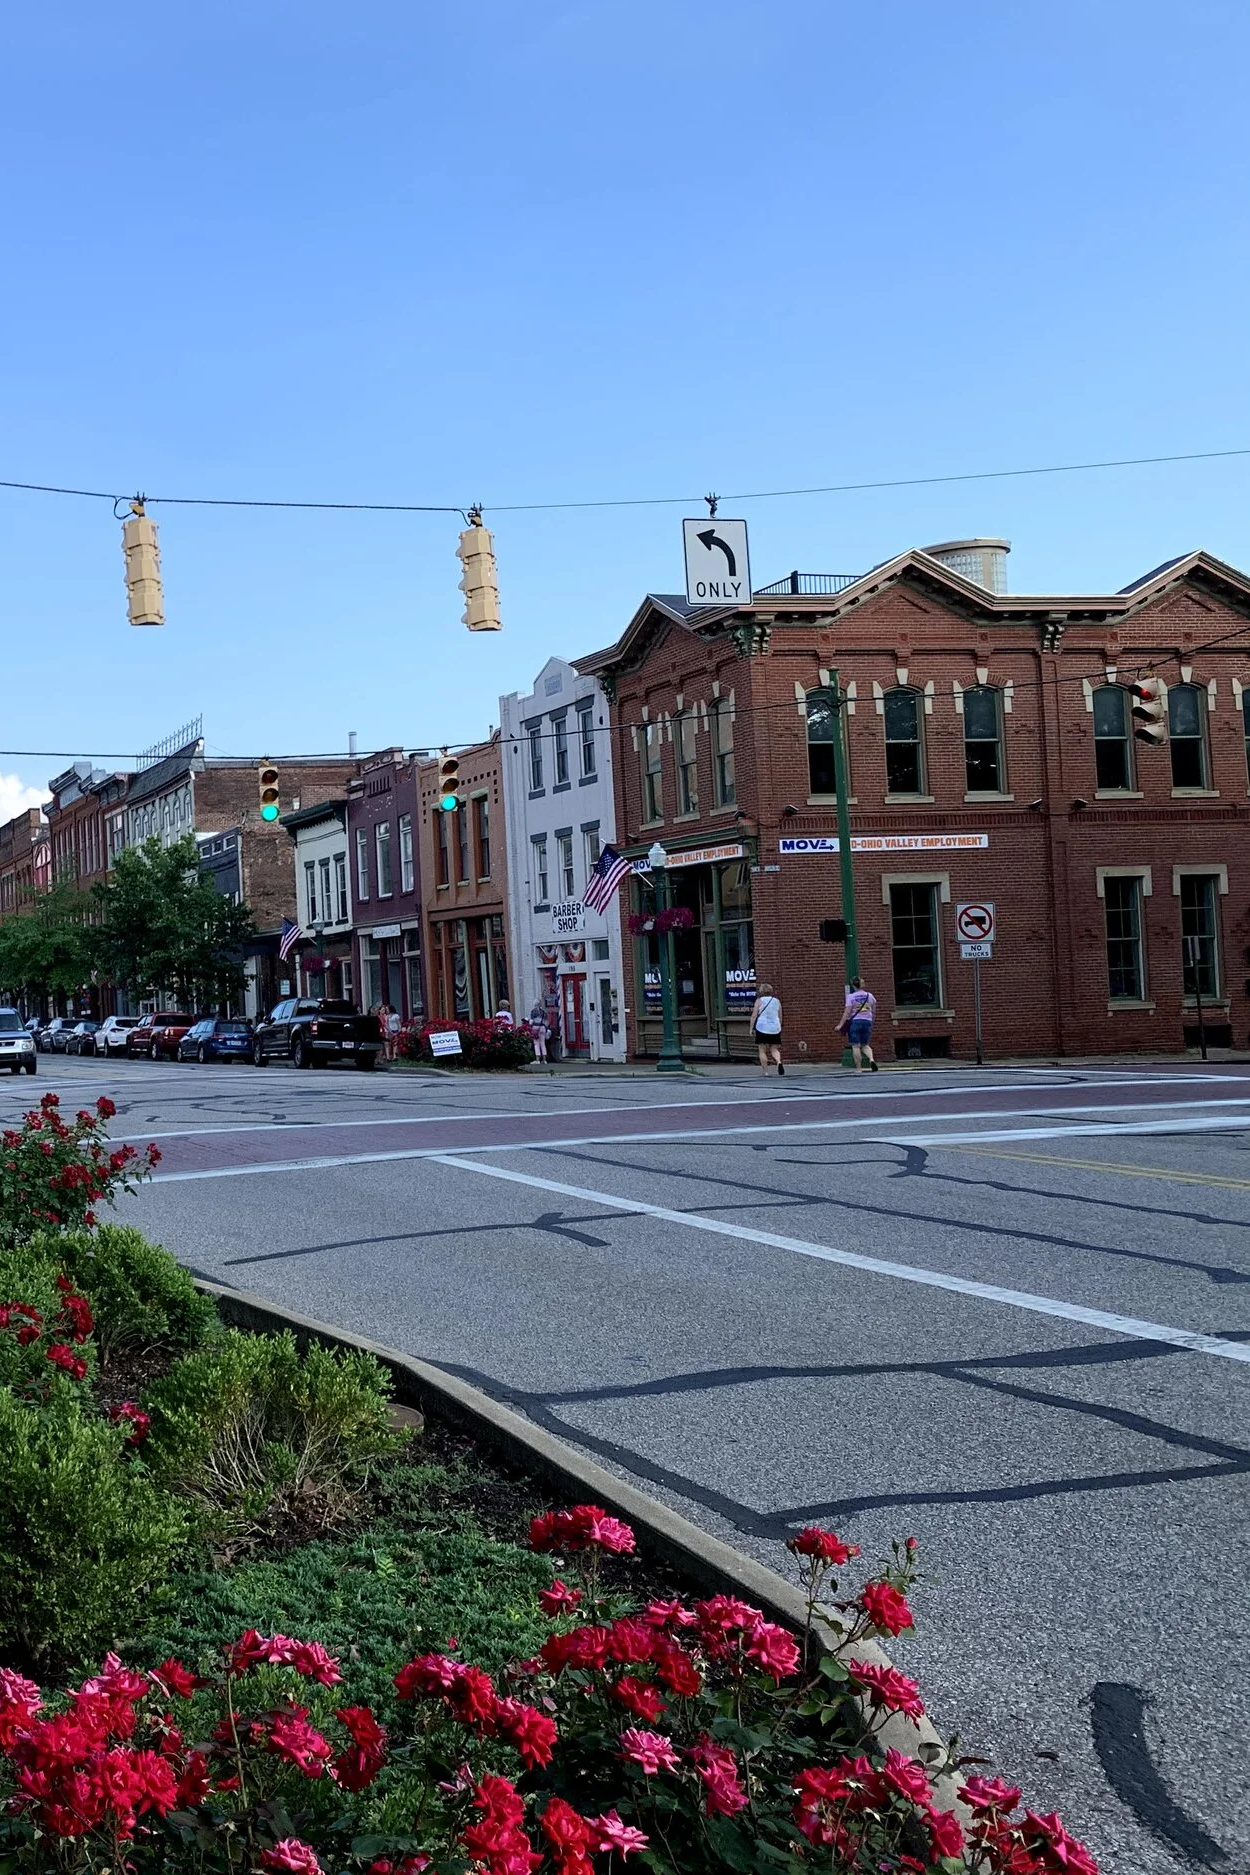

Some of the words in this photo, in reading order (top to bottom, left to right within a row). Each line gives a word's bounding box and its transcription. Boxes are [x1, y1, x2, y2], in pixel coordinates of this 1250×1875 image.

[696, 582, 742, 598] ONLY
[782, 839, 834, 851] MOVE
[851, 839, 882, 849] D-OHIO
[885, 838, 919, 848] VALLEY
[921, 836, 983, 847] EMPLOYMENT
[633, 859, 651, 871] MOV
[684, 853, 702, 864] VALLEY
[703, 846, 739, 860] EMPLOYMENT
[553, 903, 582, 918] BARBER
[558, 916, 578, 931] SHOP
[725, 968, 757, 982] MOVE
